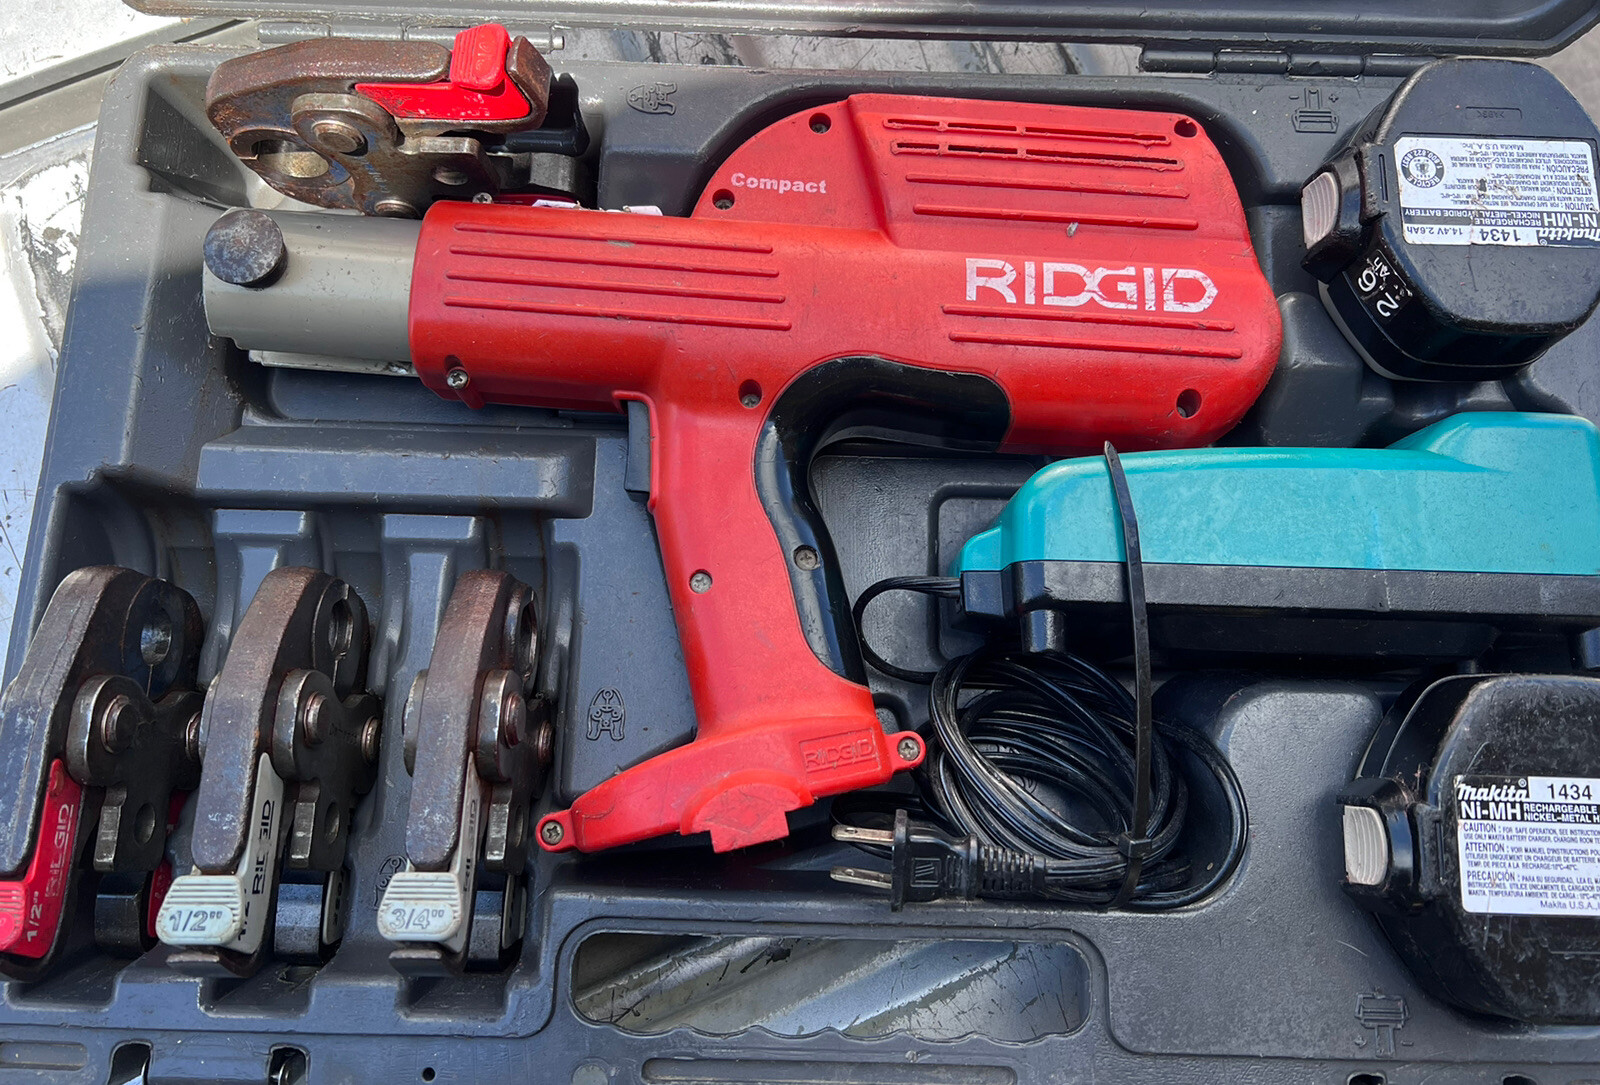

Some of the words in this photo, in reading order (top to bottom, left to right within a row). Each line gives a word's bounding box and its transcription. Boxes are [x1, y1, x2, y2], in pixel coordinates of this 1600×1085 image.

[731, 172, 826, 194] Compact
[1406, 174, 1441, 187] RECYCLE
[1556, 187, 1592, 195] ATTENTION
[1564, 202, 1594, 210] CAUTION
[1474, 217, 1541, 226] RECHARGEABLE
[1542, 212, 1597, 227] Ni-MH
[1406, 226, 1434, 234] 2.6Ah
[1479, 228, 1520, 241] 1434
[965, 257, 1219, 313] RIDGID
[803, 739, 874, 770] RIDGID
[1547, 783, 1592, 800] 1434
[1460, 800, 1521, 820] Ni-MH
[1523, 802, 1597, 814] RECHARGEABLE
[1462, 822, 1496, 832] CAUTION
[1464, 841, 1504, 852] ATTENTION
[1540, 900, 1567, 908] Makita
[169, 910, 223, 932] 1/2"
[389, 908, 445, 930] 3/4"
